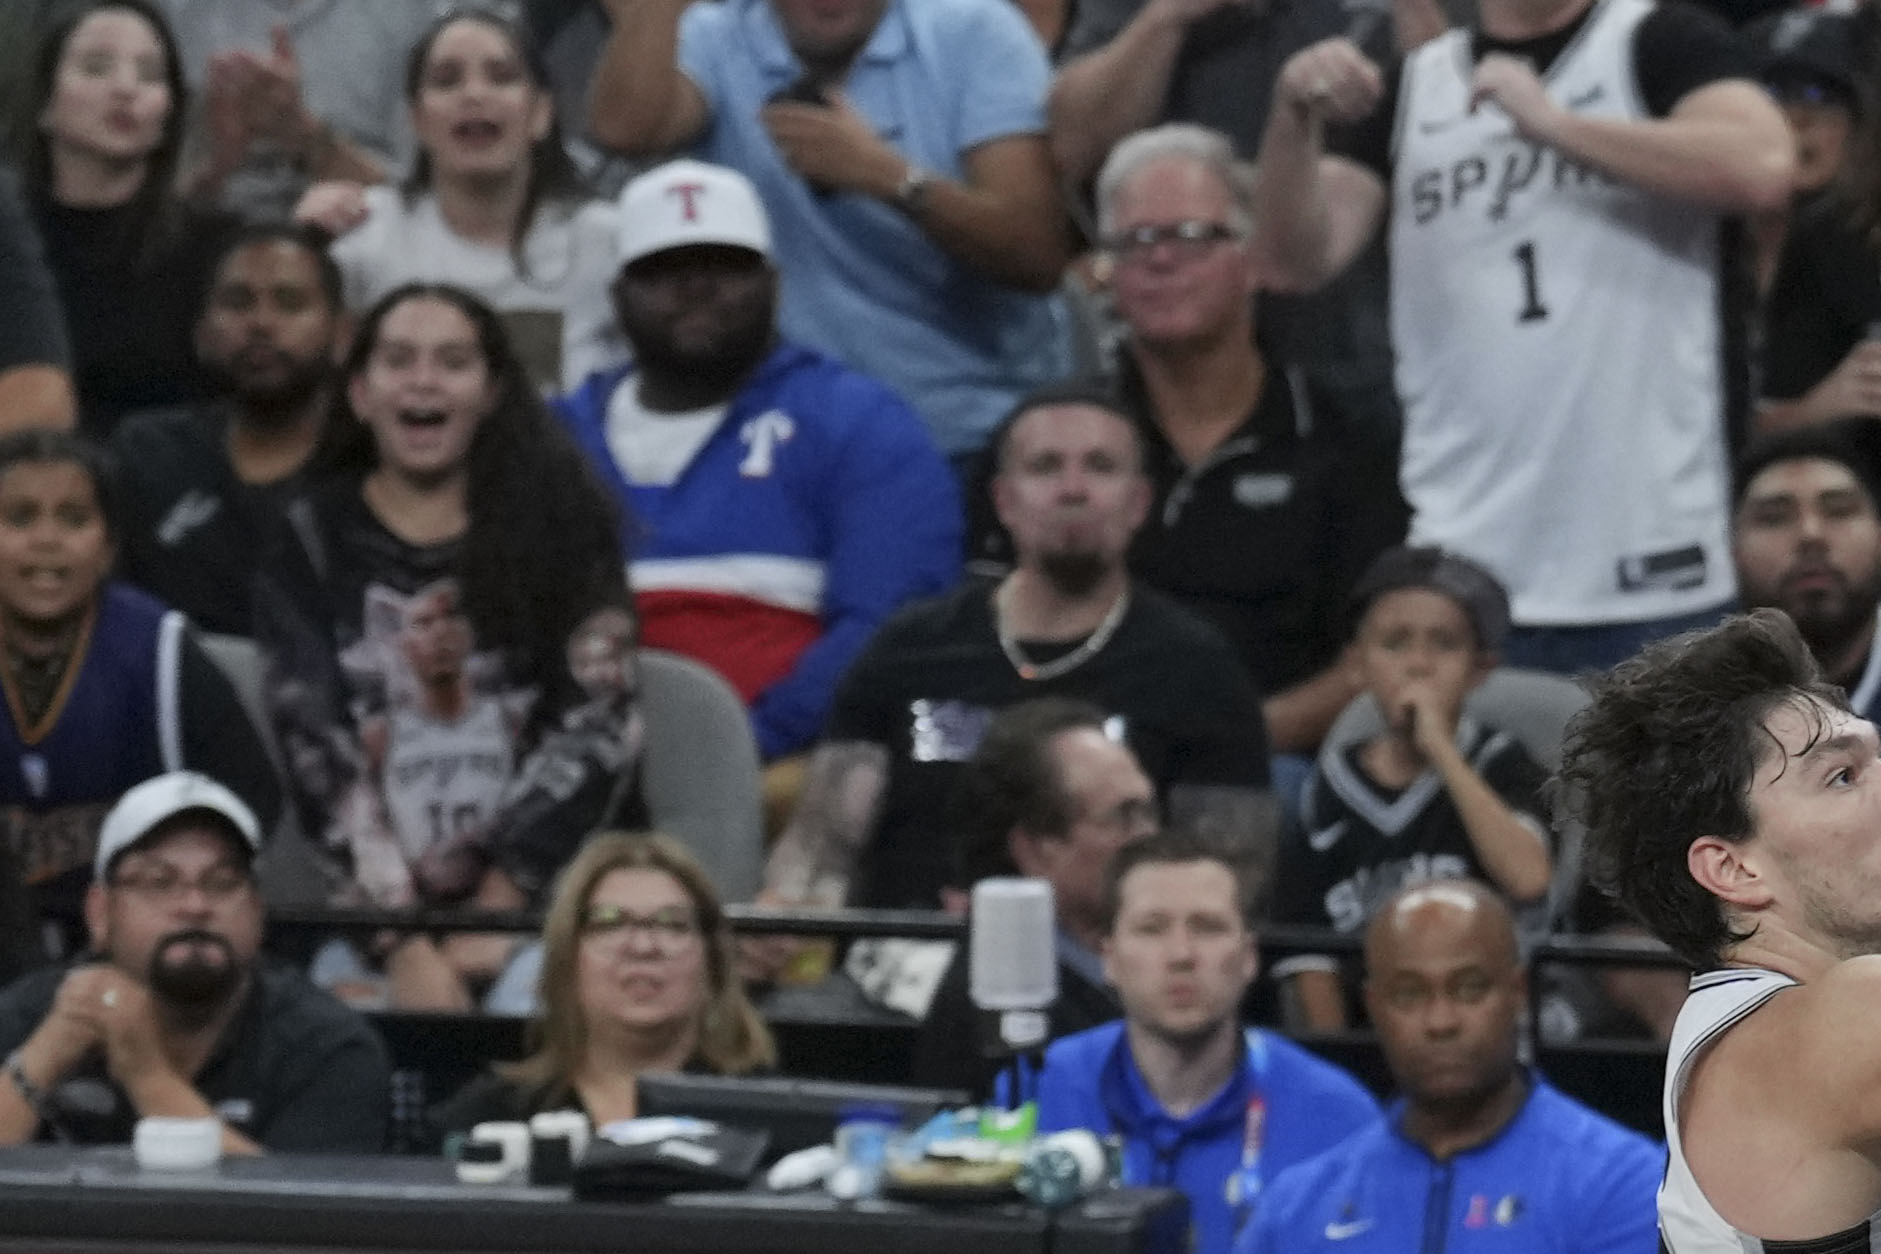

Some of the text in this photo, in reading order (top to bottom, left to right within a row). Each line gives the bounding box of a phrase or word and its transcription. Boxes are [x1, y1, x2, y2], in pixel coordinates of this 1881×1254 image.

[664, 182, 706, 222] T
[1512, 240, 1550, 326] 1
[738, 408, 797, 478] T
